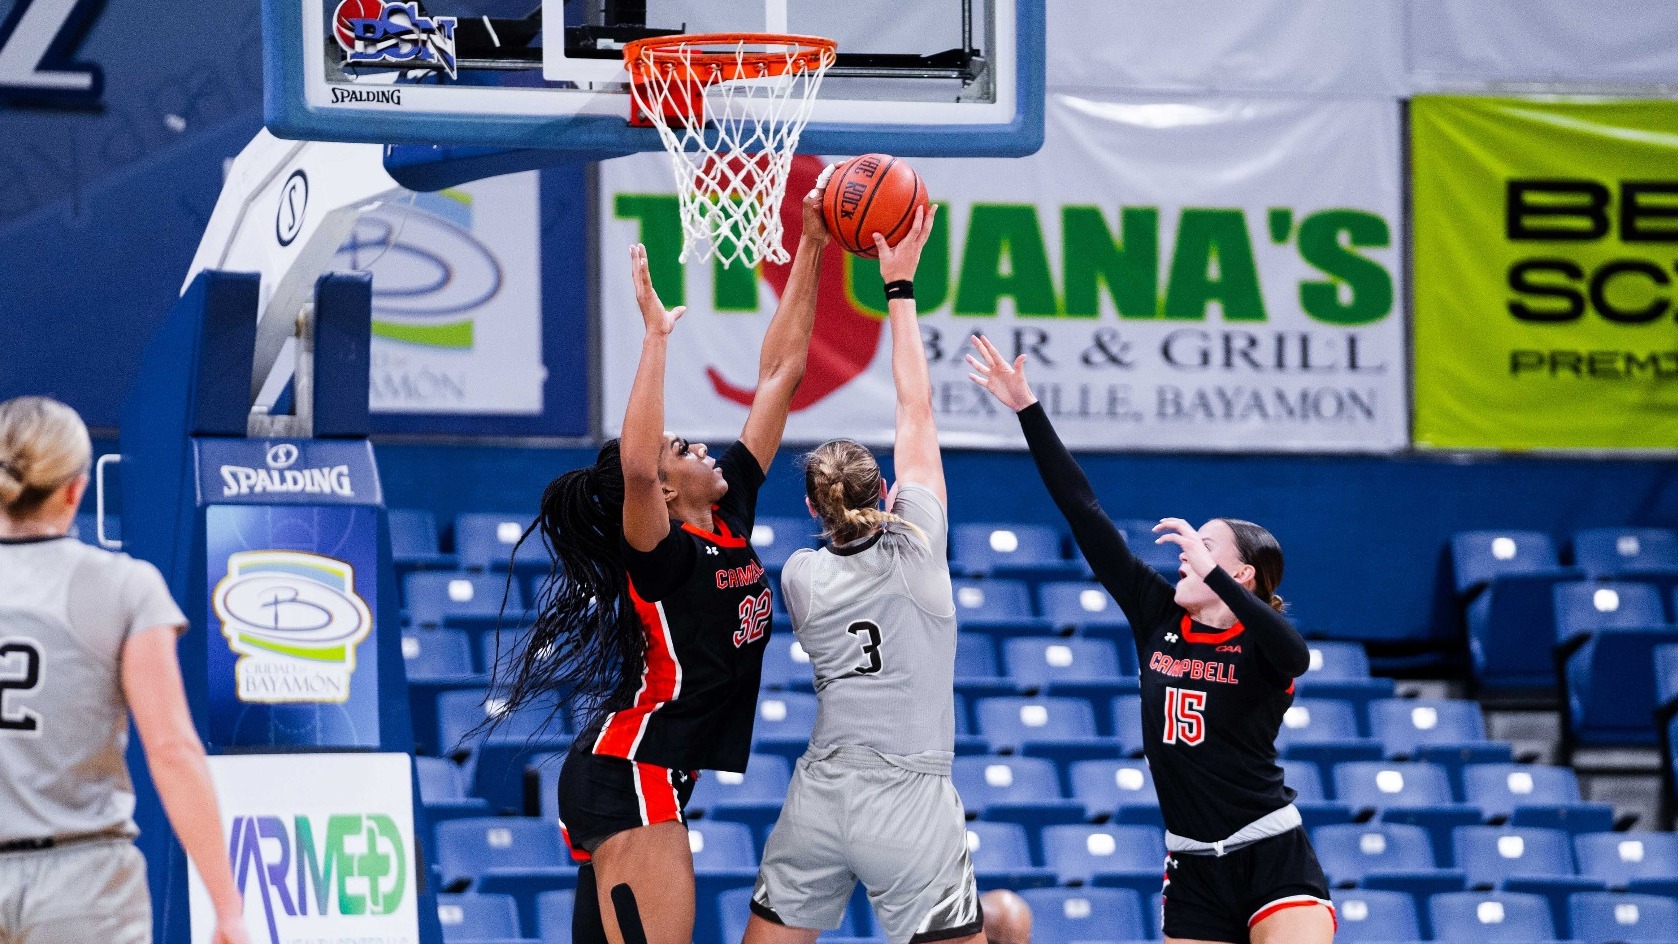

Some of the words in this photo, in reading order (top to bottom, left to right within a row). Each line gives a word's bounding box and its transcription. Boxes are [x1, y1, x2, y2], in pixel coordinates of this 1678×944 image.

[347, 3, 458, 80] BSN
[331, 87, 401, 105] SPALDING
[841, 180, 867, 220] ROCK
[1507, 258, 1678, 326] SC
[1081, 326, 1135, 370] &
[1161, 328, 1388, 374] GRILL
[1156, 384, 1377, 422] BAYAMON
[220, 465, 354, 497] SPALDING
[733, 587, 771, 649] 32
[846, 618, 883, 675] 3
[1149, 651, 1239, 684] CAMPBELL
[1215, 645, 1242, 654] CAA
[1162, 686, 1207, 747] 15
